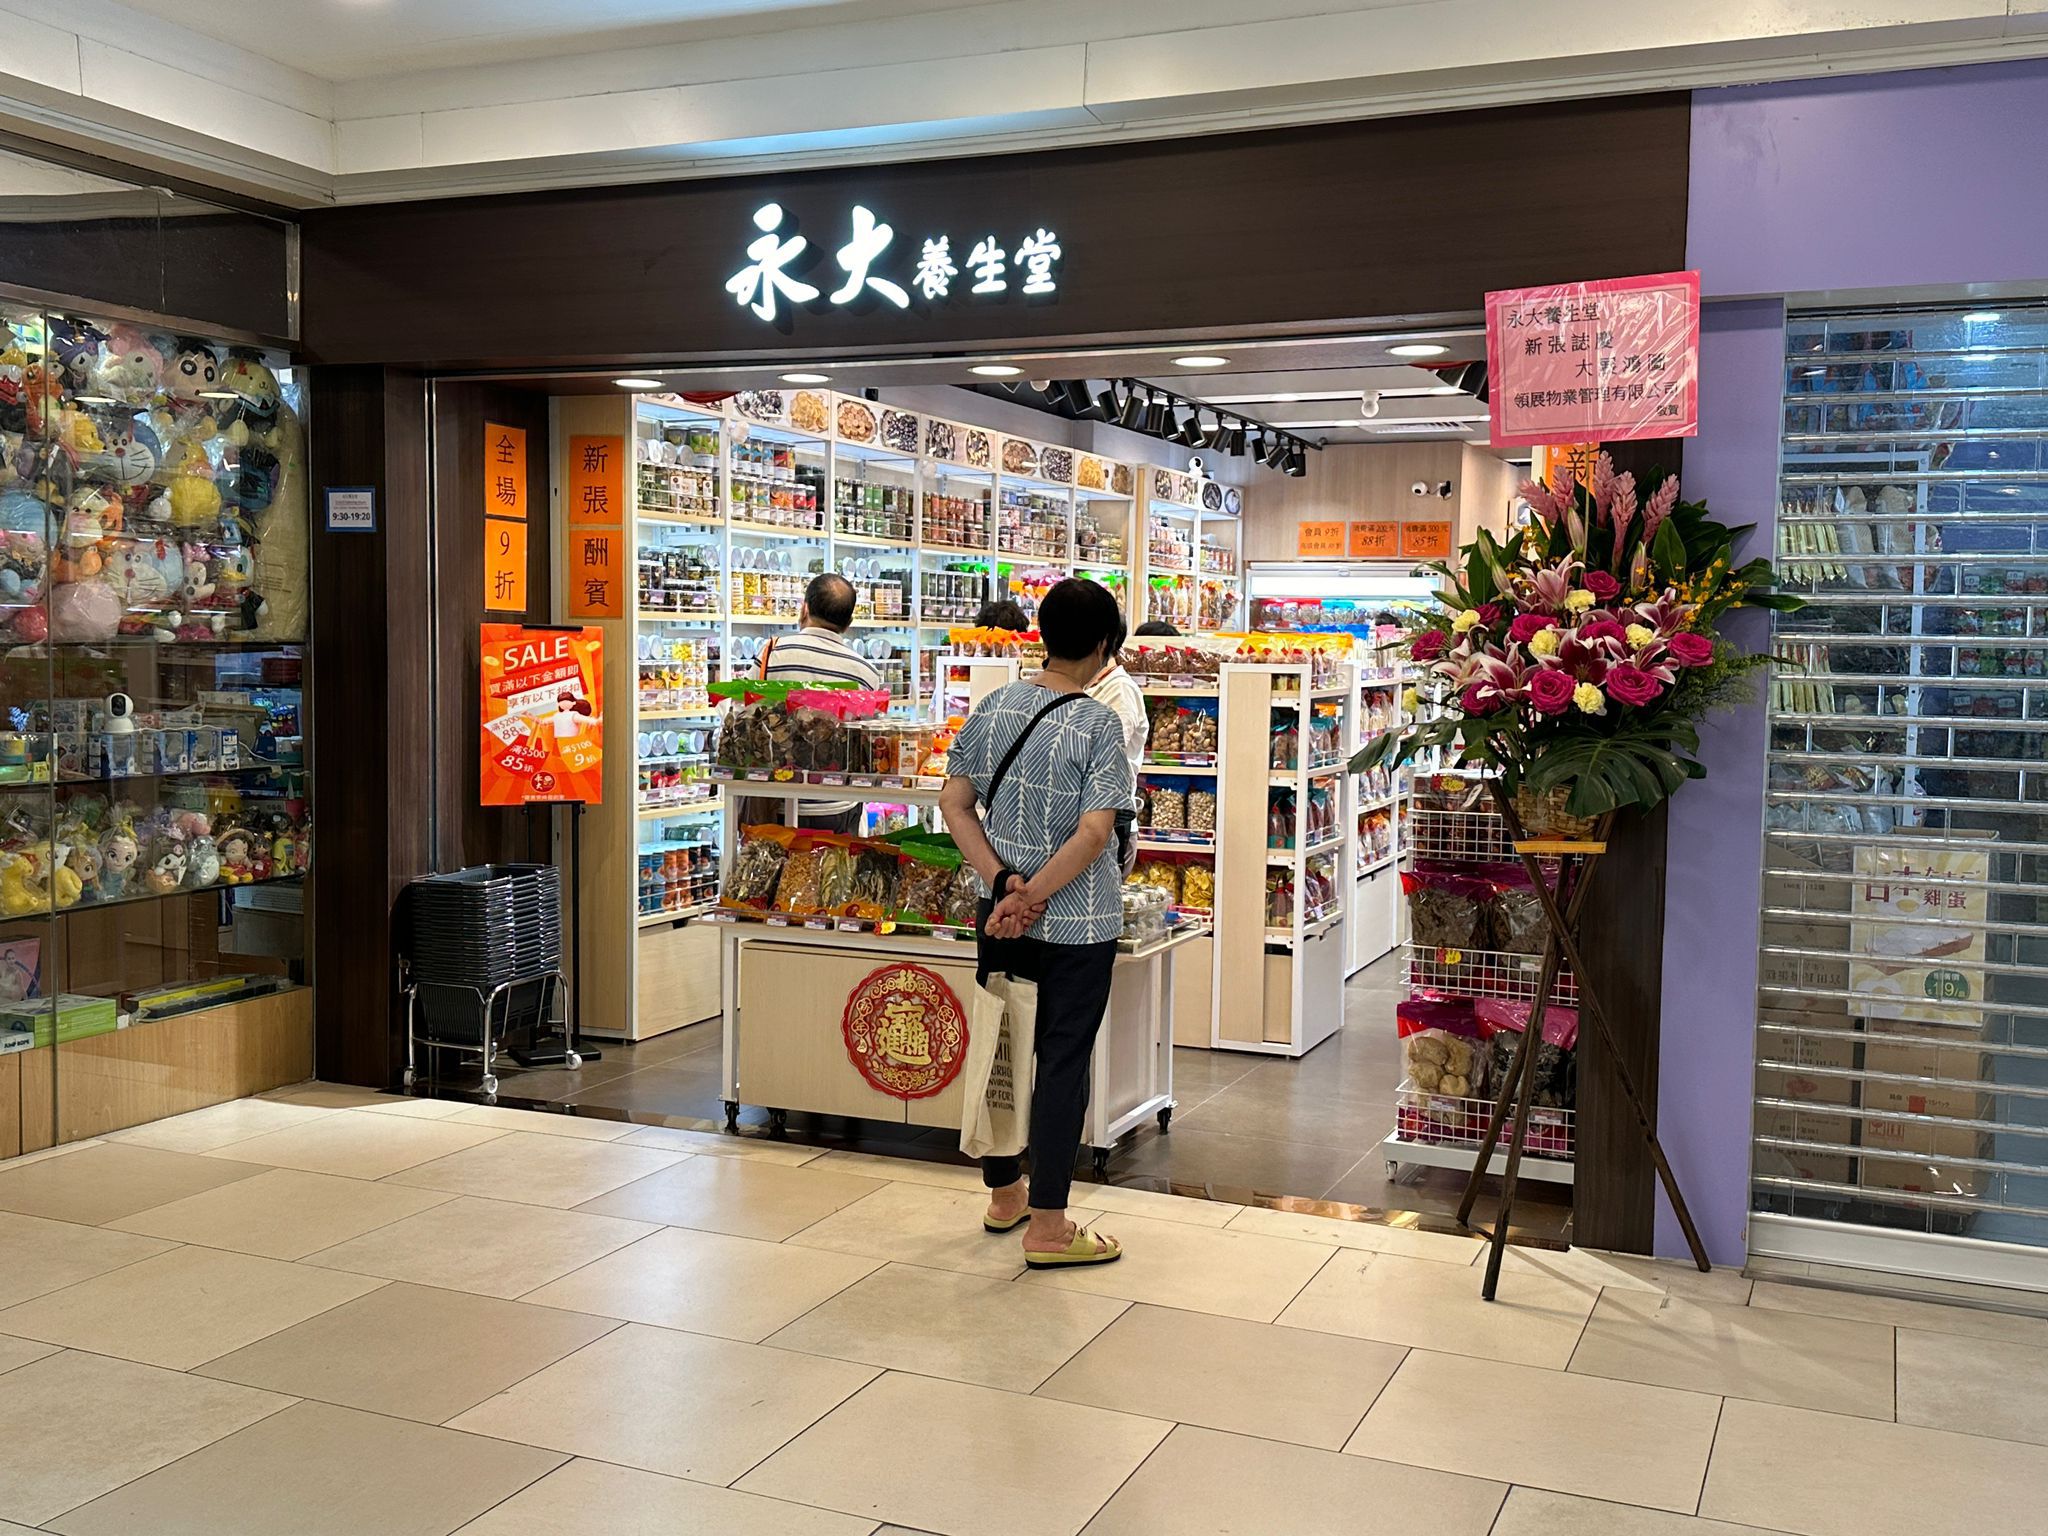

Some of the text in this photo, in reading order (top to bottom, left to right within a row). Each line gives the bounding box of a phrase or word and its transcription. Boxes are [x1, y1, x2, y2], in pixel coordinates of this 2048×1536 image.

[725, 203, 1062, 322] 永大養生堂
[332, 512, 371, 521] 9:30-19:20
[494, 434, 517, 600] 全場9折
[583, 444, 609, 608] 新張酬賓
[504, 636, 569, 671] SALE
